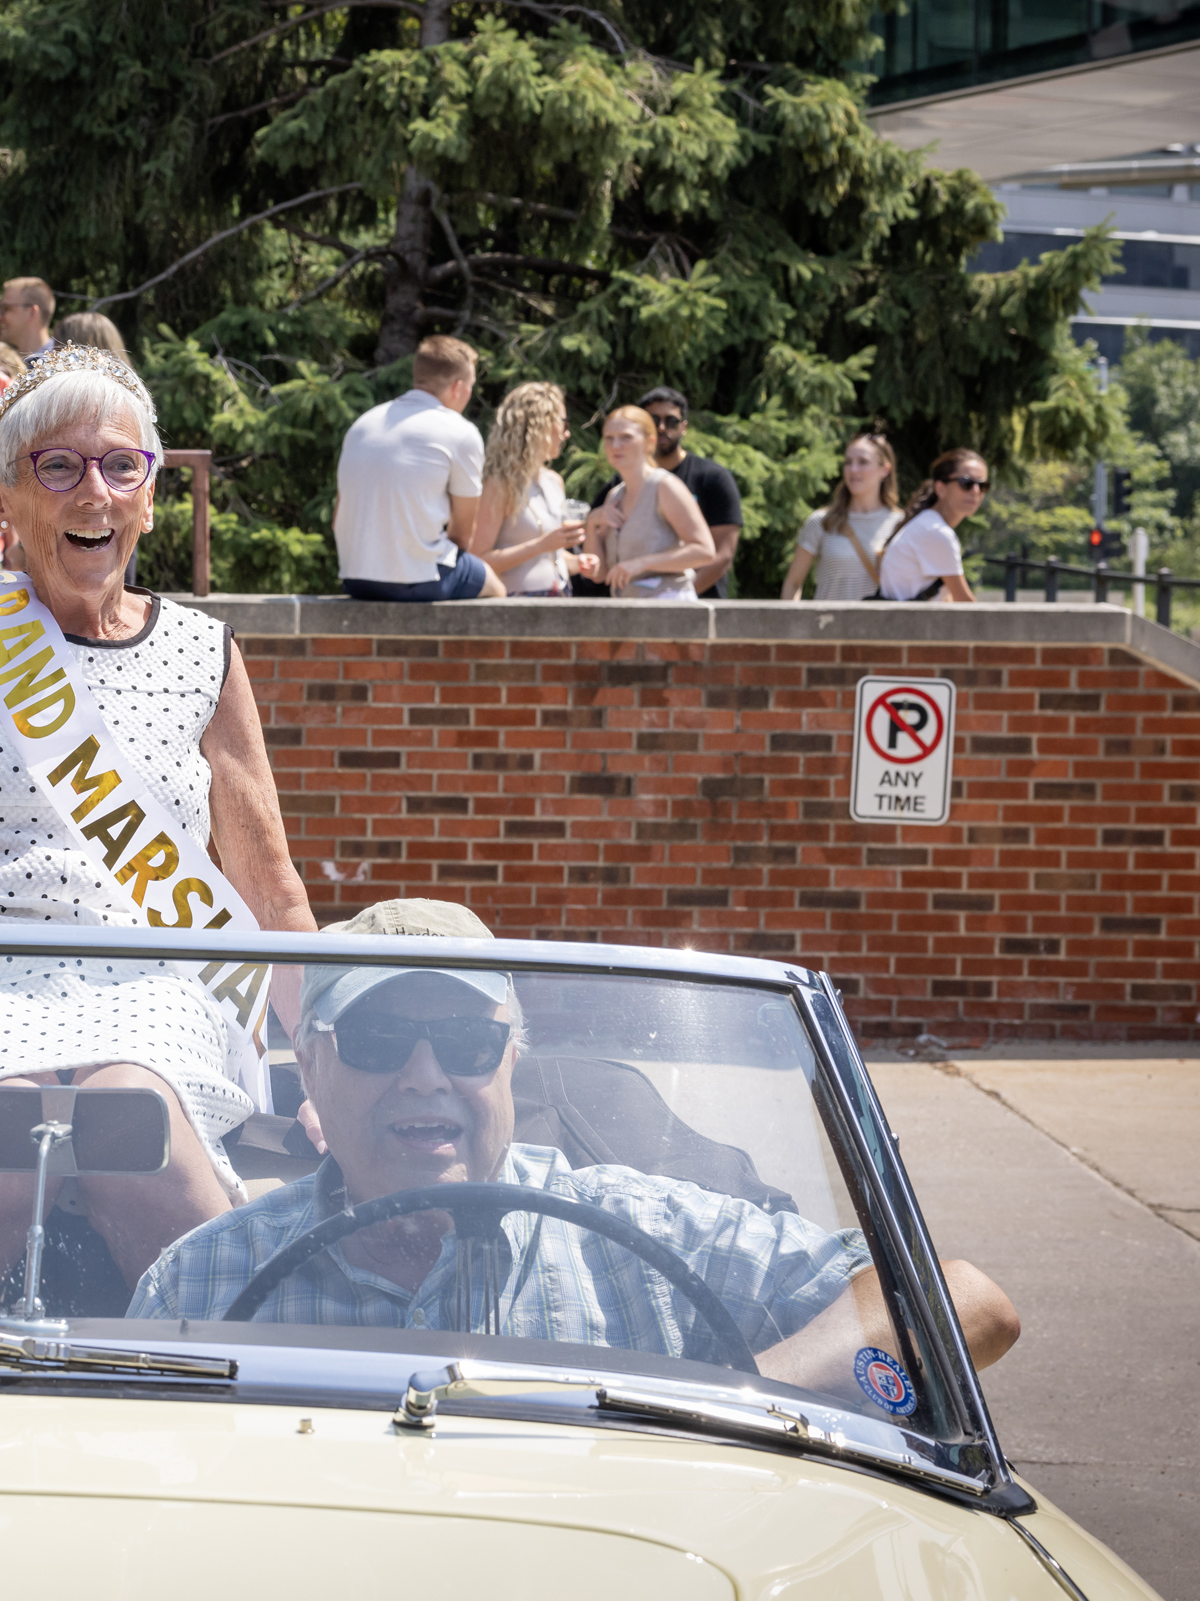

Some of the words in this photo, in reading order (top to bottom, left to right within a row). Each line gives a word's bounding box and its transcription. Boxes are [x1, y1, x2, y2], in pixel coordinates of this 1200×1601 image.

[879, 770, 923, 788] ANY
[874, 793, 926, 813] TIME
[856, 1349, 914, 1395] AUSTIN-HEALEY
[864, 1384, 883, 1405] CLUB
